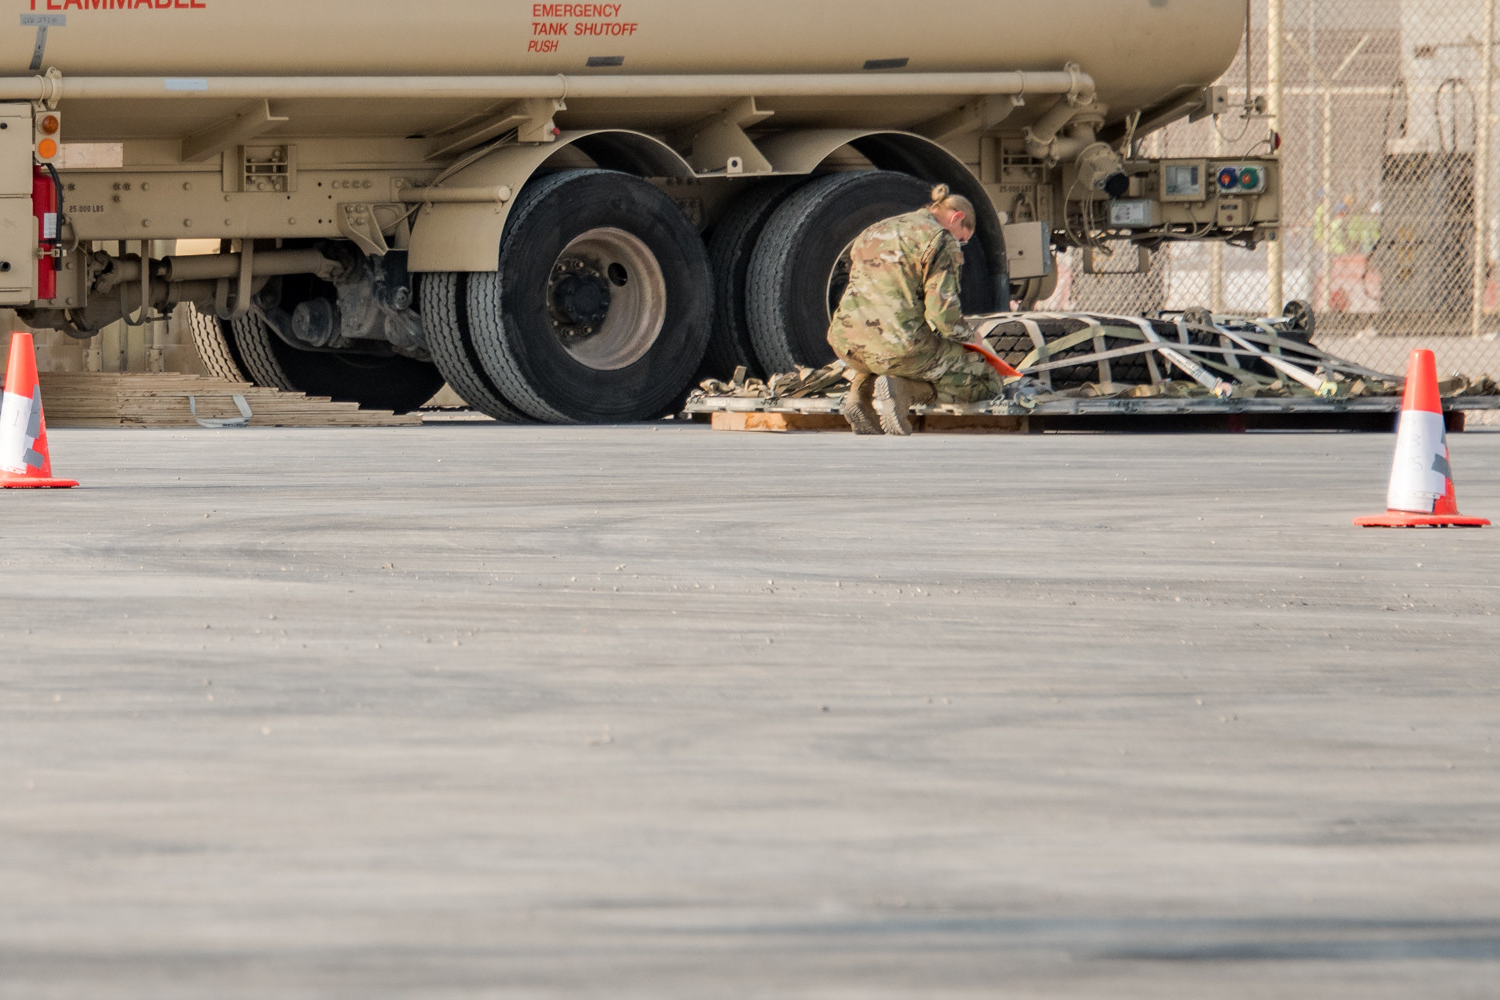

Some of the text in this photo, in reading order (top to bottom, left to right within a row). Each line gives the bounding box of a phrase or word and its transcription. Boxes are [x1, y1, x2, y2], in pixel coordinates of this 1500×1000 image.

[532, 3, 622, 18] EMERGENCY
[531, 21, 638, 37] TANK SHUTOFF
[527, 39, 559, 54] PUSH
